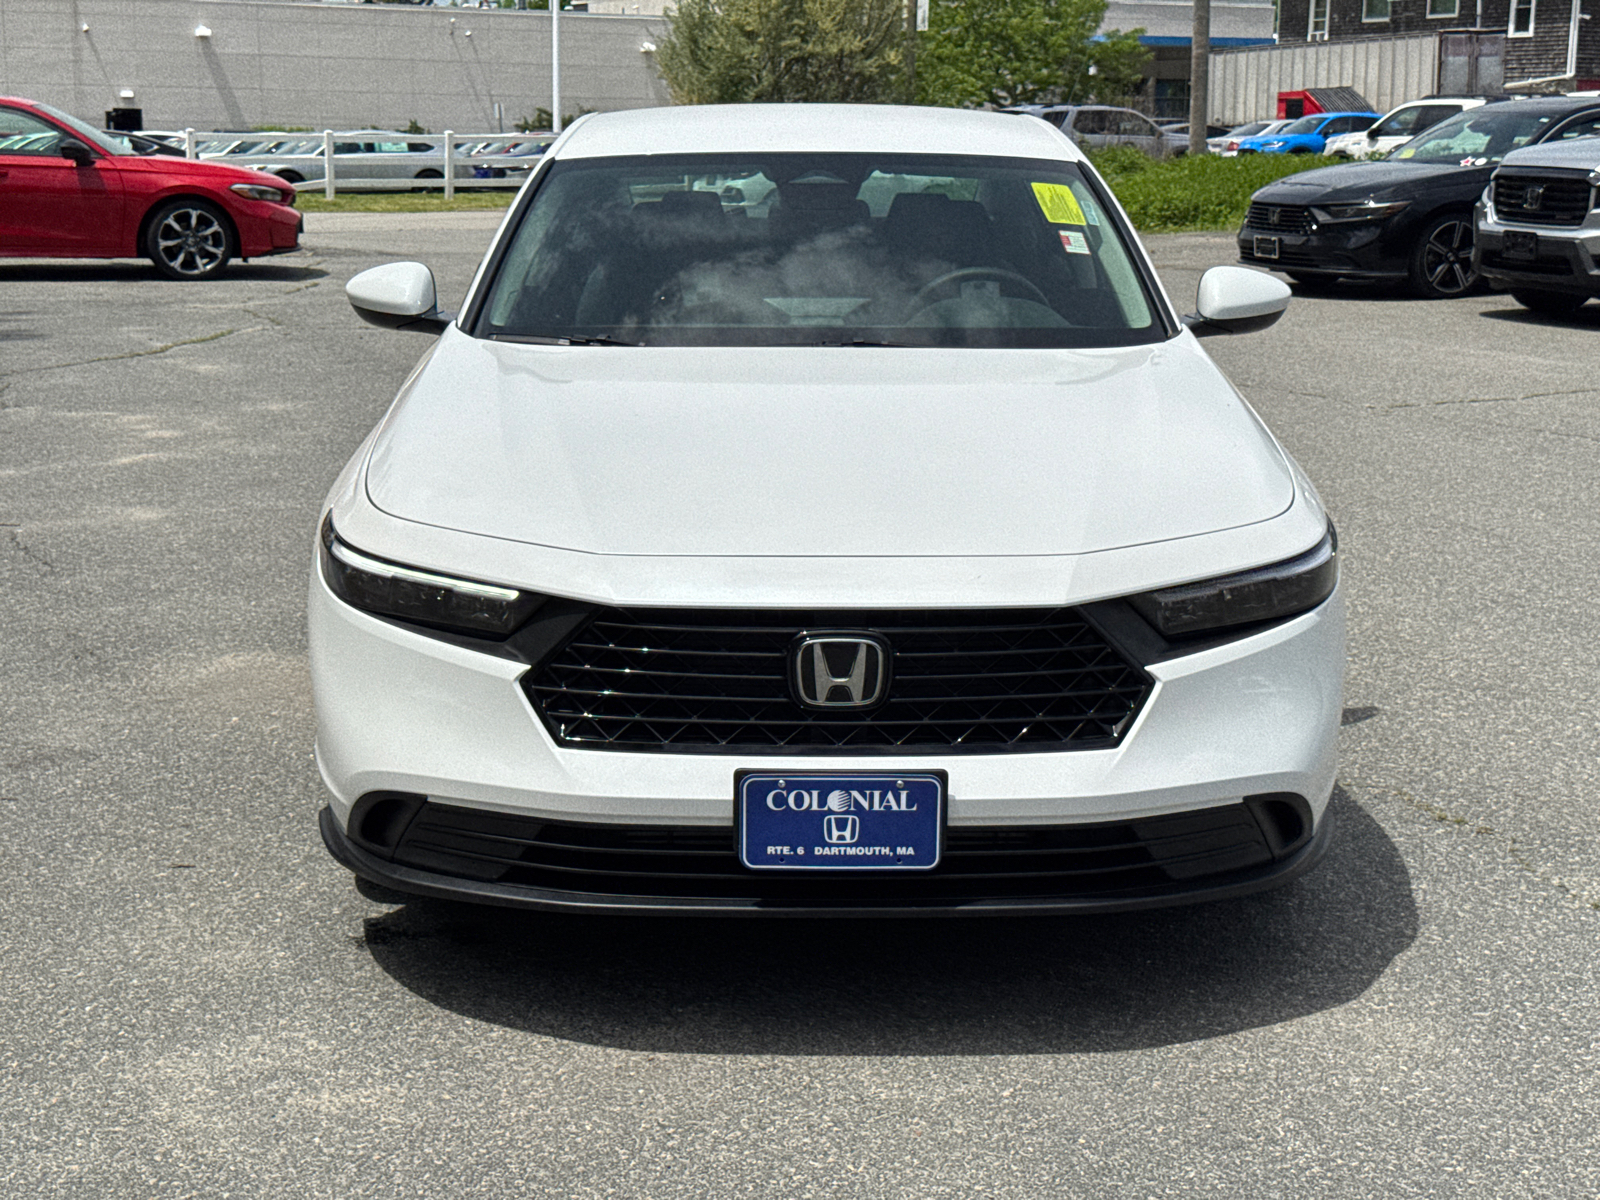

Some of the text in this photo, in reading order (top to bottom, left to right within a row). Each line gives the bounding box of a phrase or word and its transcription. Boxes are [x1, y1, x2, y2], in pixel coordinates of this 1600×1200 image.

[766, 789, 917, 812] COLONIAL
[767, 846, 915, 857] RTE. 6 DARTMOUTH, MA
